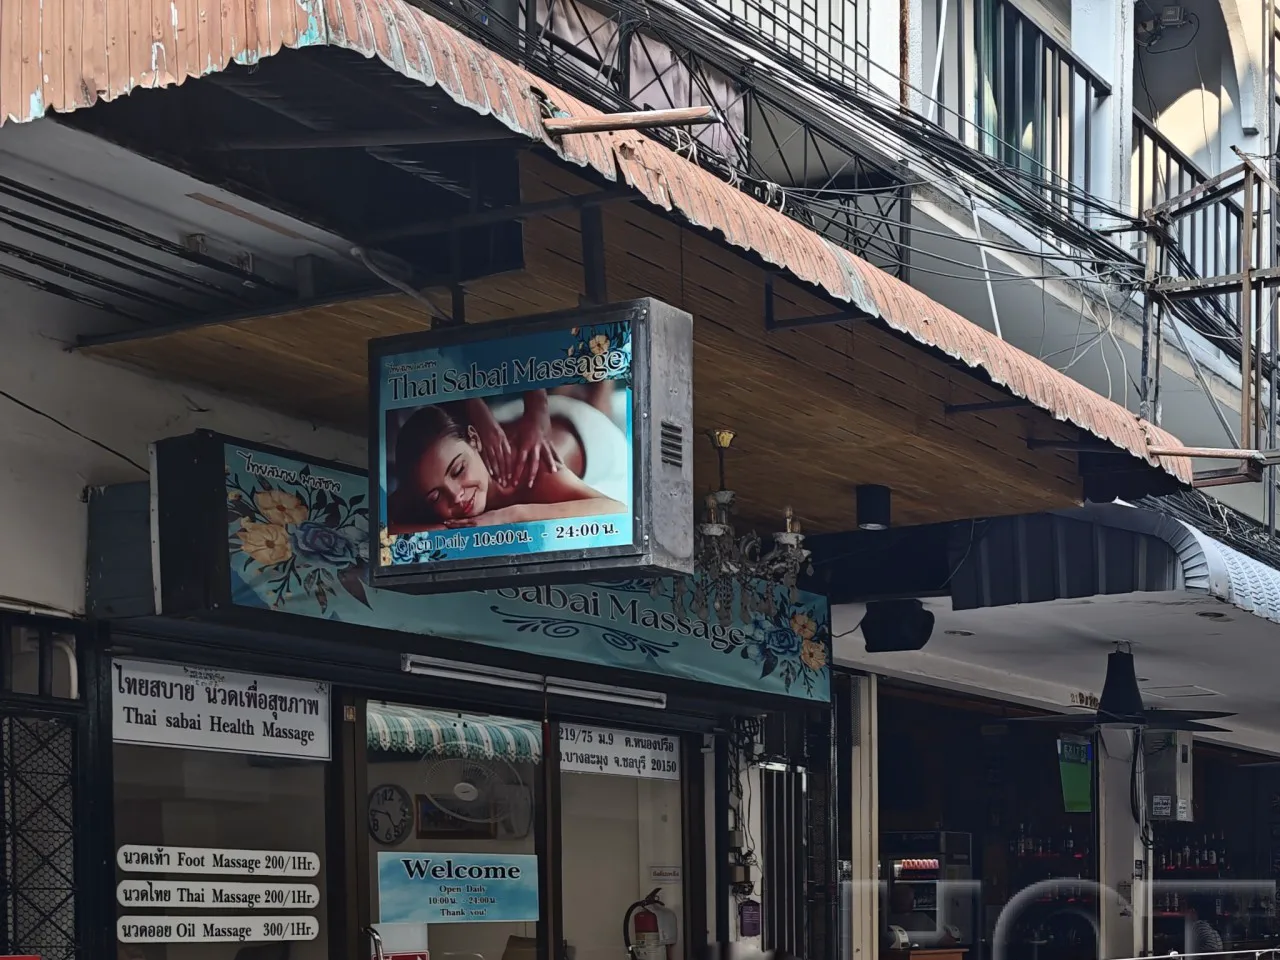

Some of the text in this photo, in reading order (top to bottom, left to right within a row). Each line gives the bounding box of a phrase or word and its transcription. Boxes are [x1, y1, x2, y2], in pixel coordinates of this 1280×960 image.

[388, 351, 623, 400] Thai Sabai Massage
[395, 536, 433, 553] Open
[436, 533, 469, 550] Daily
[473, 530, 514, 547] 10:00
[556, 522, 599, 539] 24:00
[608, 594, 746, 653] Massage
[113, 663, 195, 701] ไทยสบาย
[205, 680, 319, 720] นวดเพื่อสุขภาพ
[123, 706, 315, 746] Thai sabai Health Massage
[559, 727, 593, 744] 219/75
[651, 758, 677, 772] 20150
[123, 847, 315, 873] นวดเท้า Foot Massage 200/1Hr.
[401, 859, 521, 880] Welcome
[123, 880, 315, 909] นวดไทย Thai Massage 200/1Hr.
[439, 885, 486, 895] Open Daily
[440, 908, 465, 916] Thank
[122, 922, 315, 941] นวดออย Oil Massage 300/1Hr.
